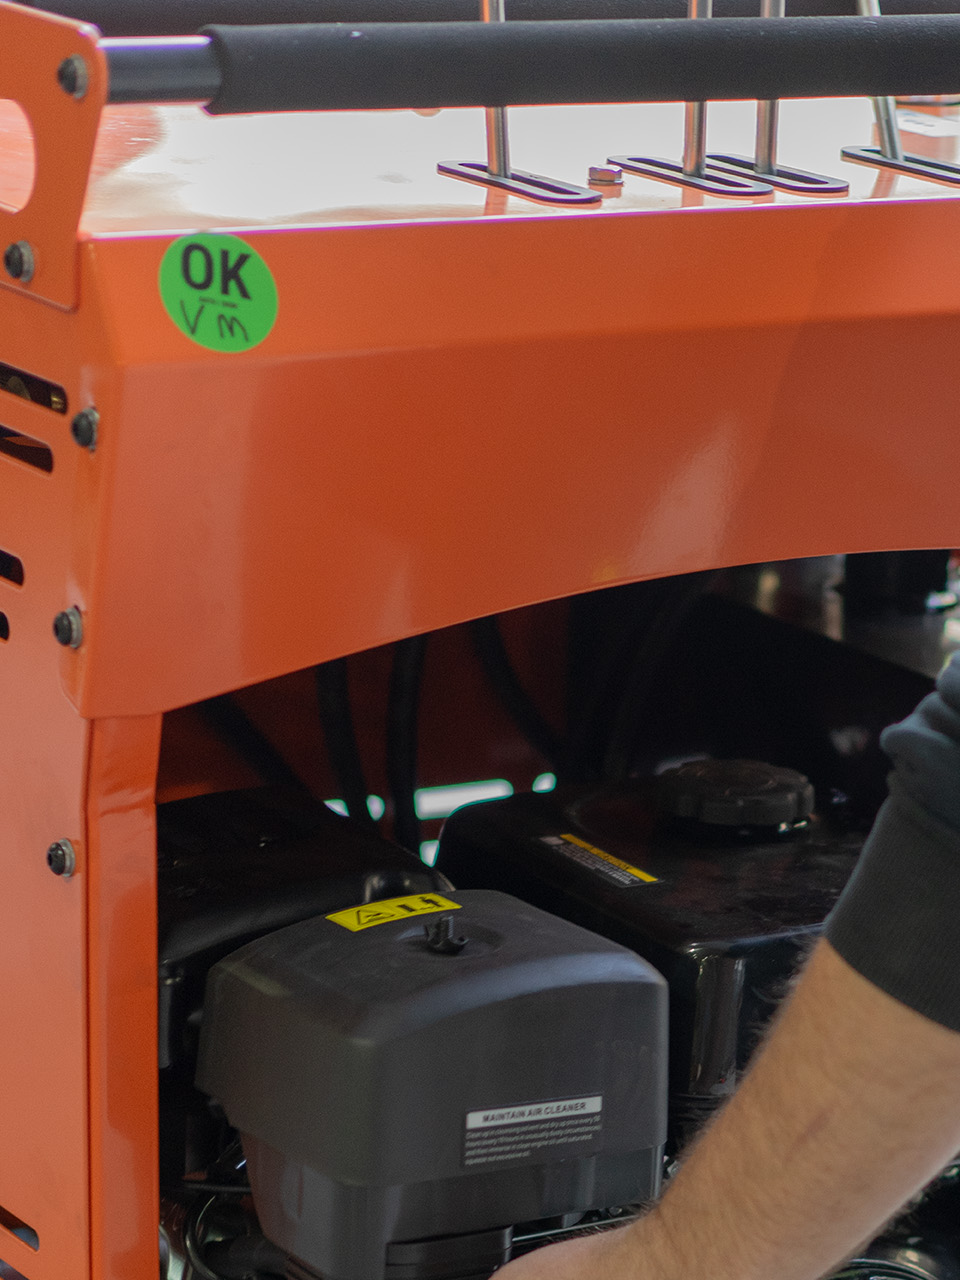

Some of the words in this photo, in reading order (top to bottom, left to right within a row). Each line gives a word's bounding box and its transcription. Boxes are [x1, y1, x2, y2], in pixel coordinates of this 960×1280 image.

[181, 242, 252, 300] OK
[482, 1111, 526, 1123] MAINTAIN
[527, 1107, 543, 1117] AIR
[543, 1102, 586, 1115] CLEANER
